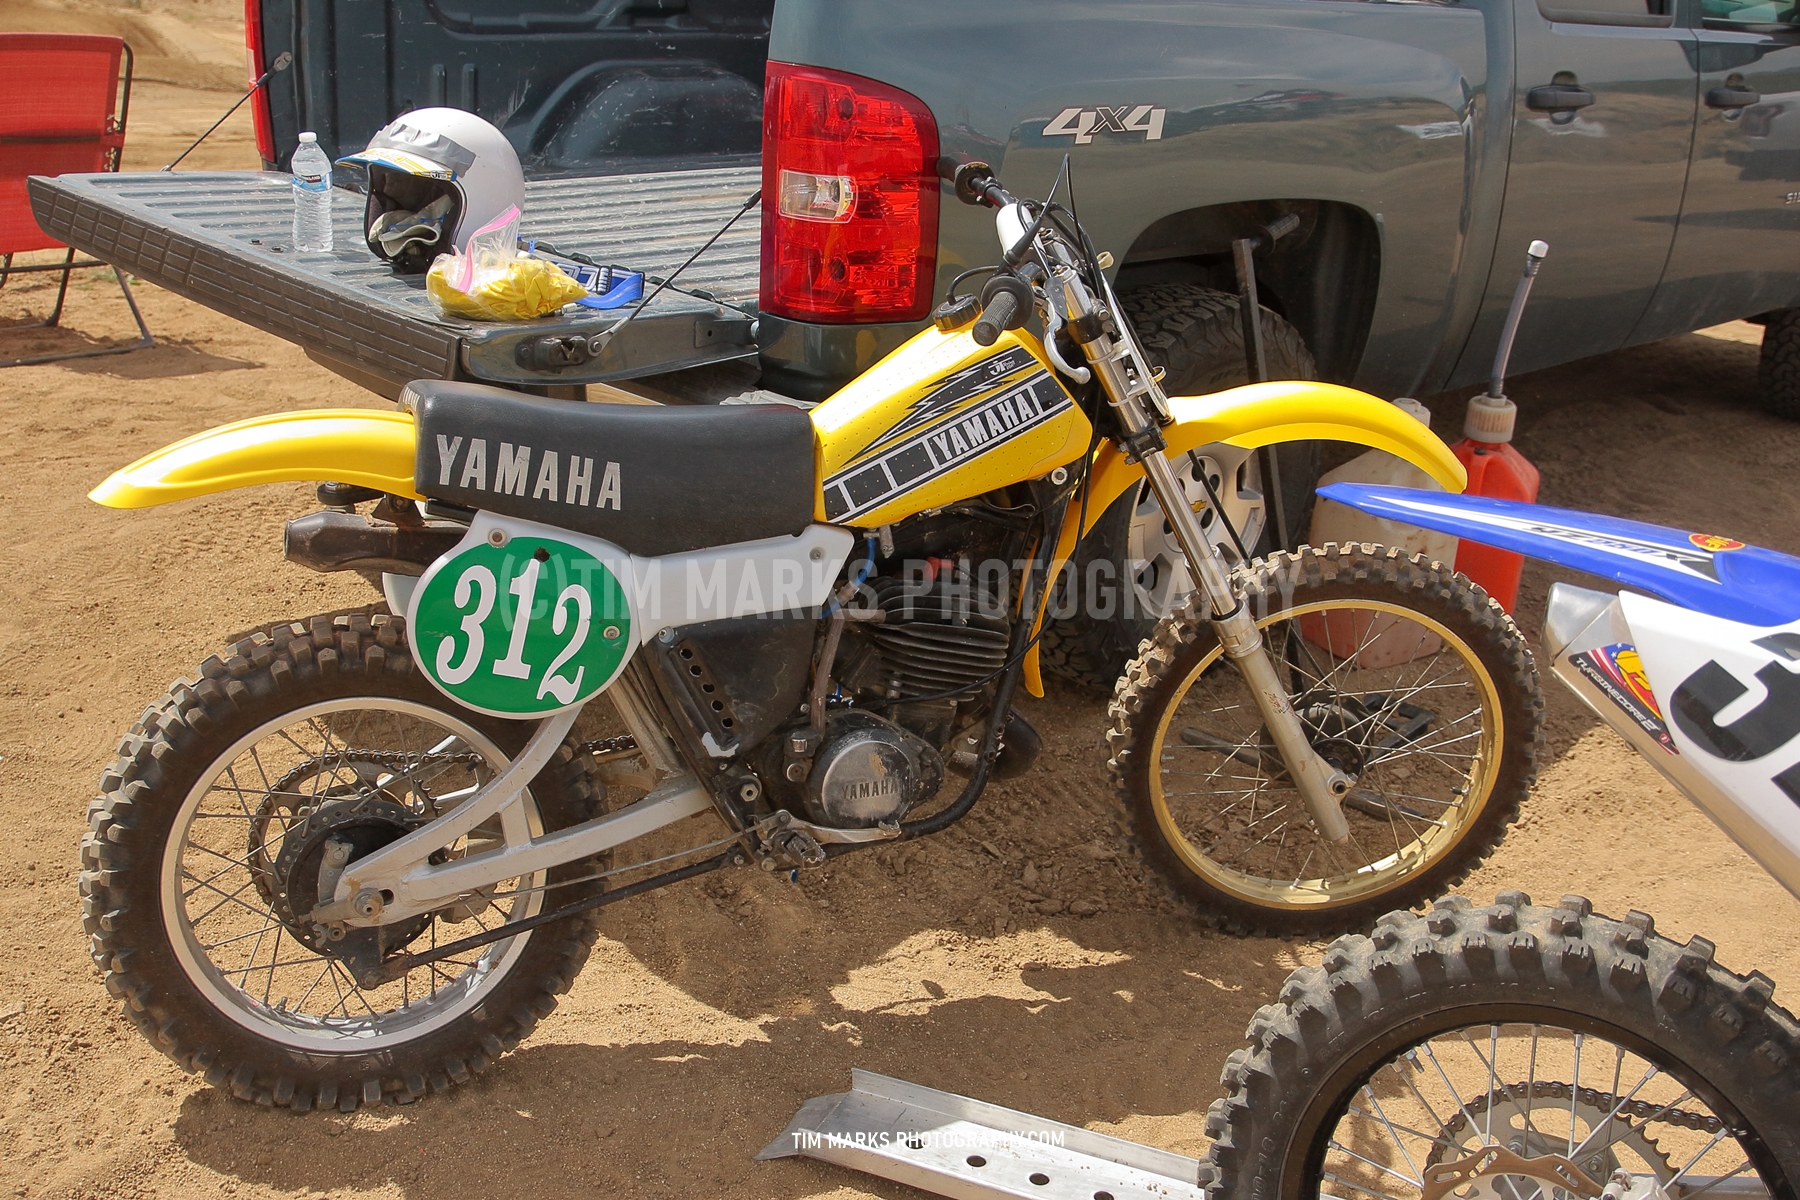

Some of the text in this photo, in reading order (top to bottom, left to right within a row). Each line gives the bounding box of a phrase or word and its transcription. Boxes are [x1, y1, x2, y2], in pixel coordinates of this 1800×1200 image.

[932, 392, 1036, 461] YAMAHA
[436, 434, 622, 511] YAMAHA
[435, 558, 592, 705] 312
[841, 780, 899, 800] YAMAHA
